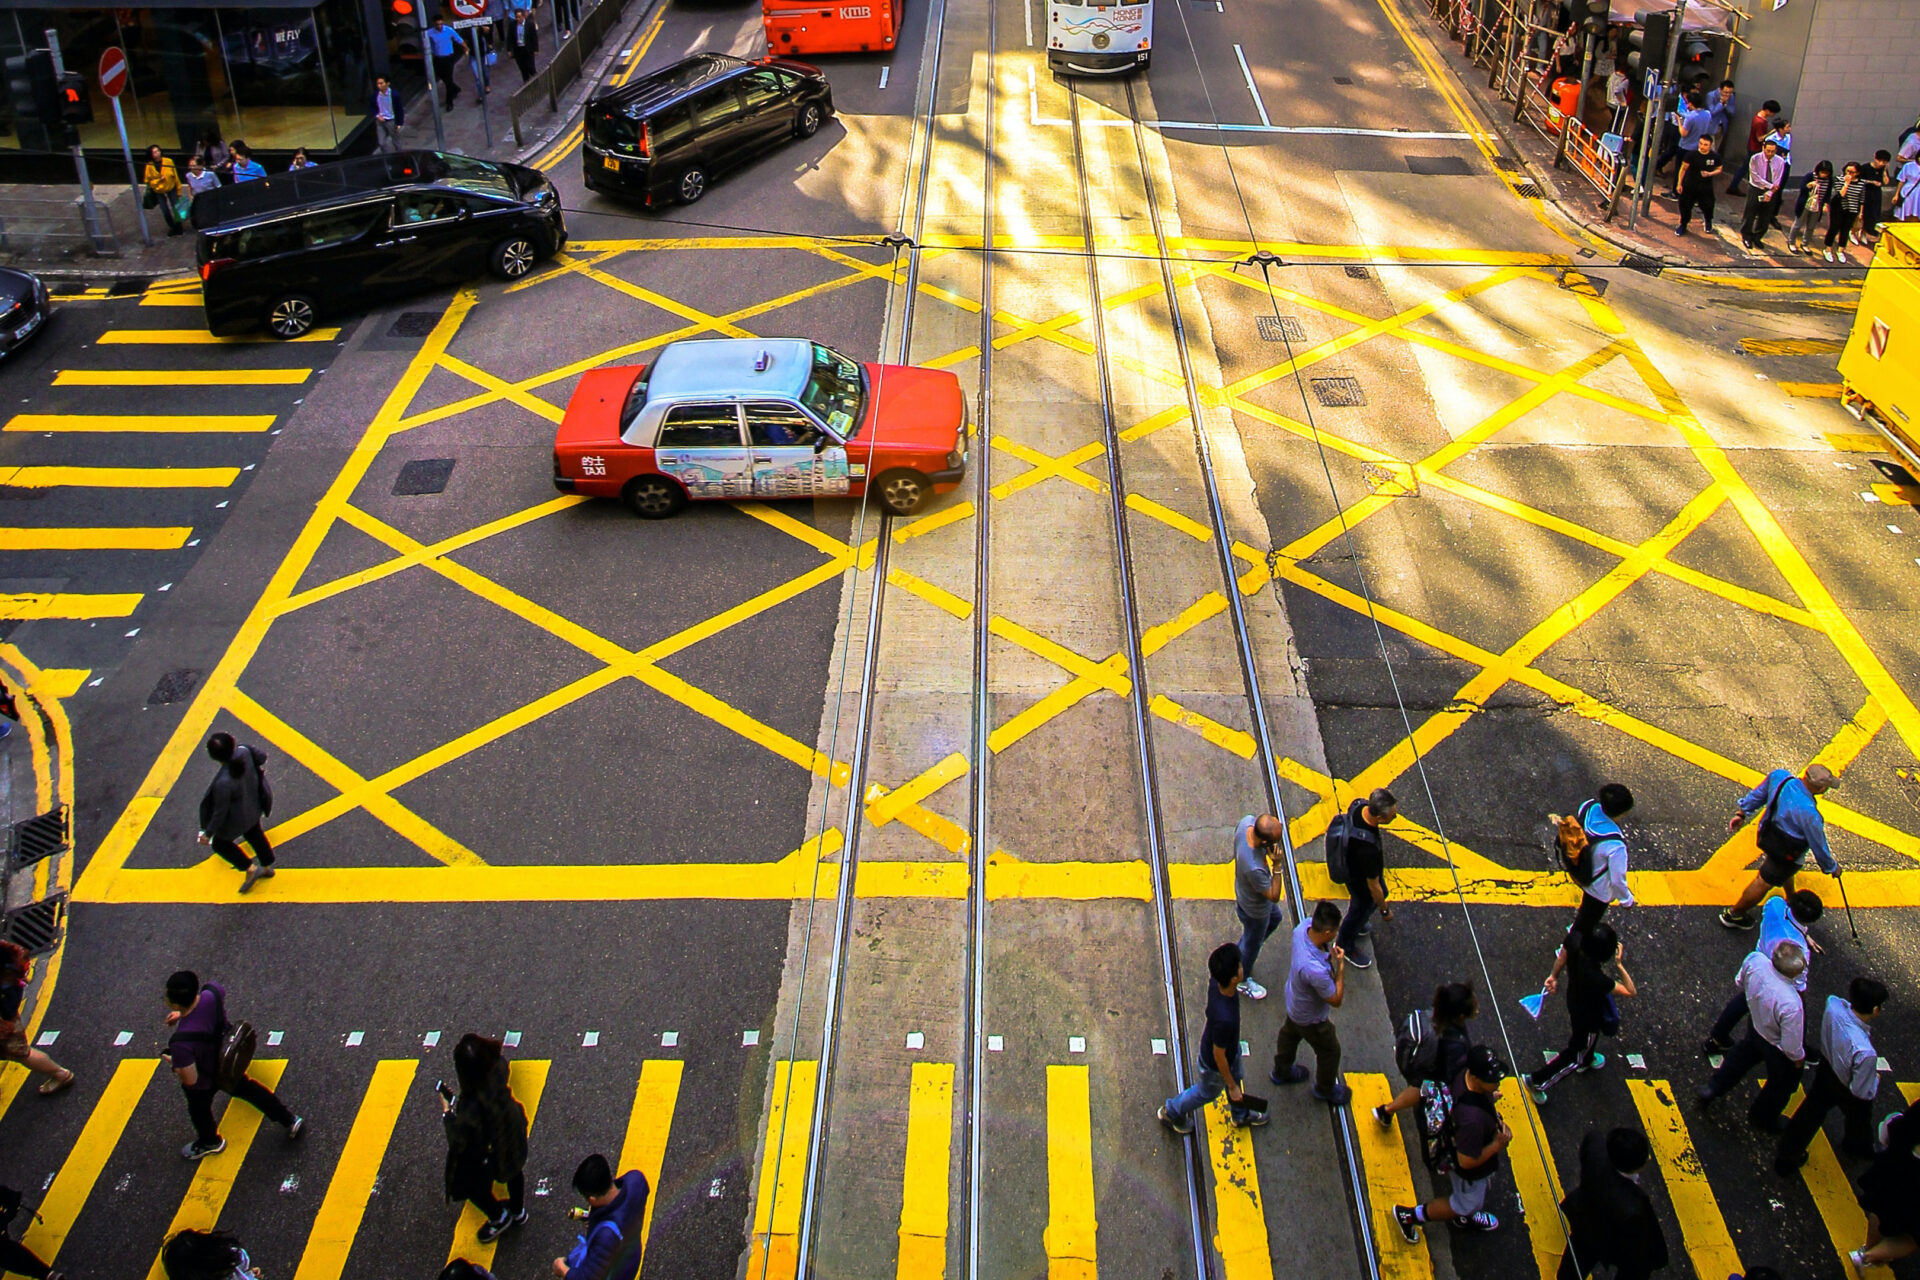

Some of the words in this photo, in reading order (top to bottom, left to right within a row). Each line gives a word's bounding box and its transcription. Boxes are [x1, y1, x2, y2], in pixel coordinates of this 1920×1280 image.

[840, 6, 871, 19] KMB
[1113, 8, 1137, 16] HONG
[1113, 14, 1137, 22] KONG
[286, 29, 301, 41] FLY
[1137, 53, 1148, 62] 151
[581, 455, 605, 466] 的士
[582, 466, 606, 475] TAXI
